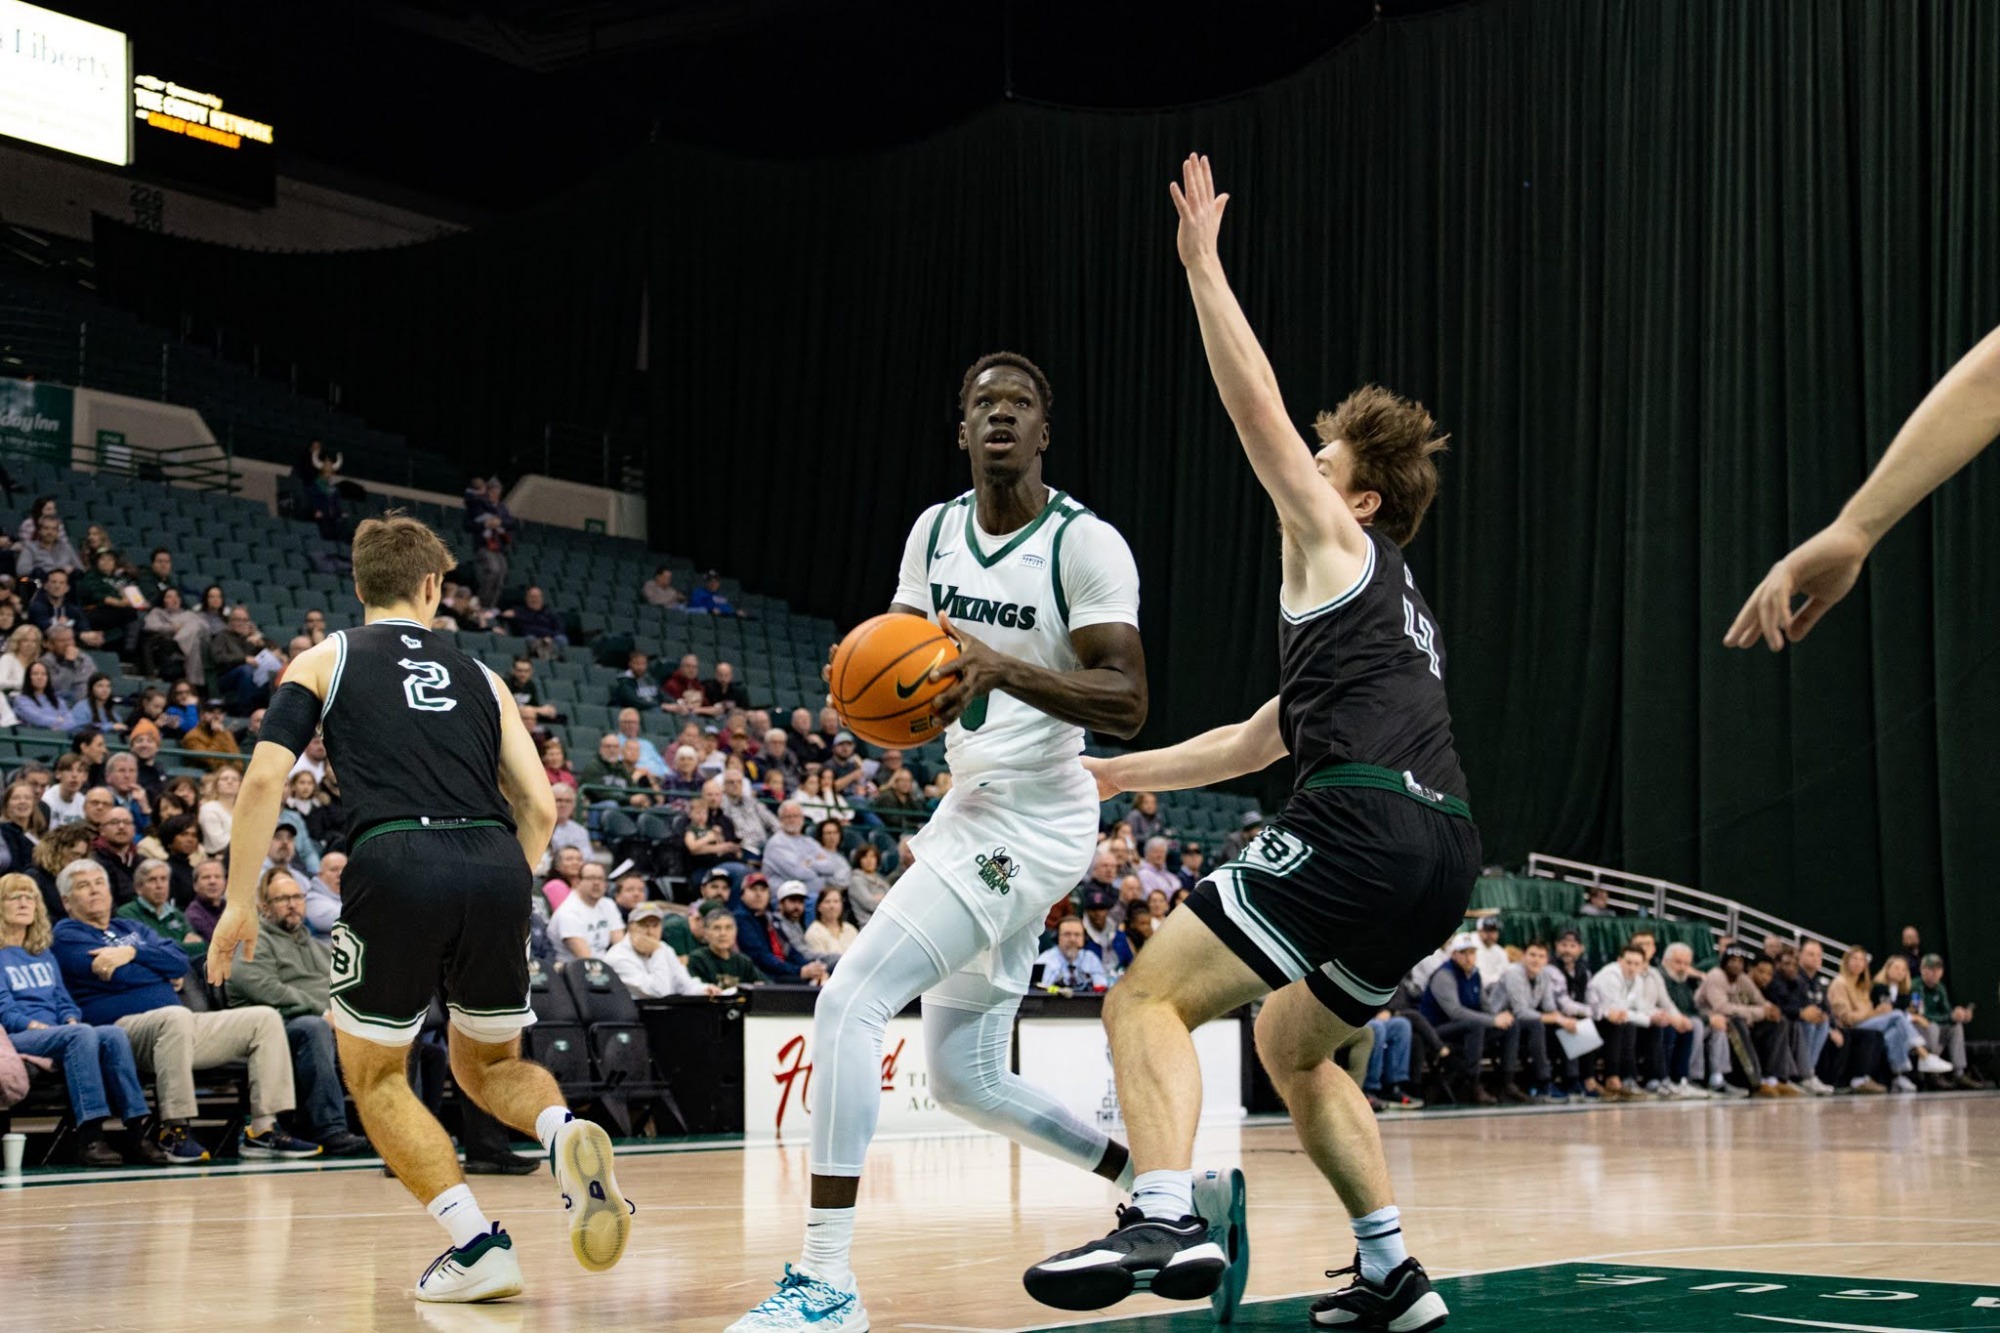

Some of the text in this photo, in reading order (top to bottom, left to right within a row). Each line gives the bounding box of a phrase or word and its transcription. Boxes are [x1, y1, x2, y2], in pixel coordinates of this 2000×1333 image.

[930, 583, 1037, 631] VIKINGS
[1402, 593, 1442, 681] 4
[397, 658, 458, 712] 2
